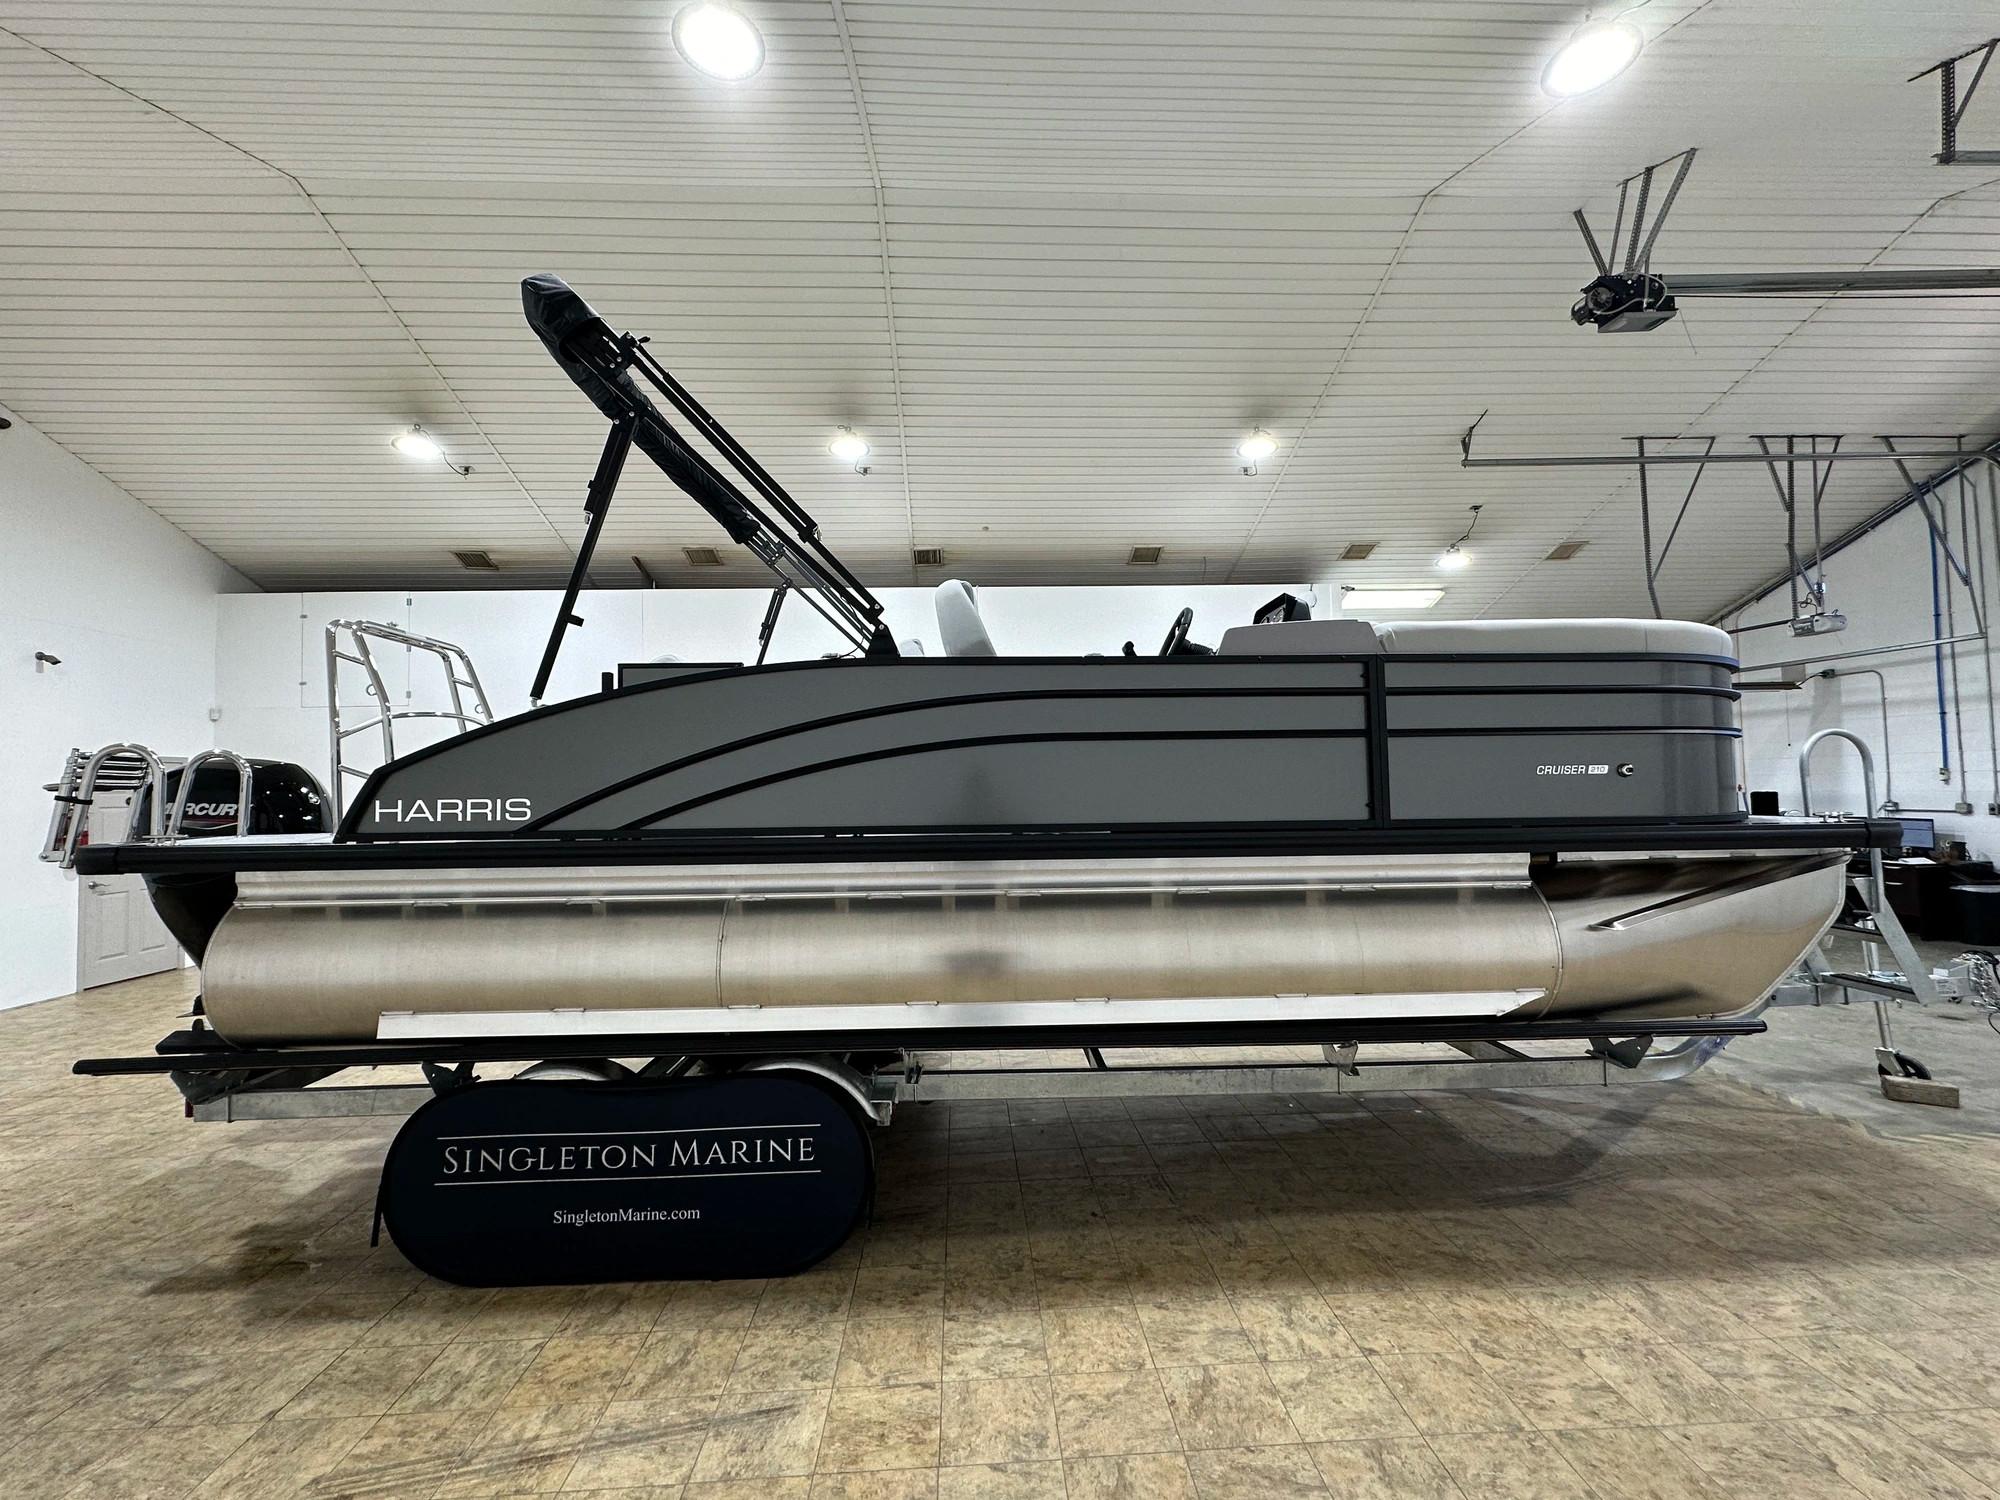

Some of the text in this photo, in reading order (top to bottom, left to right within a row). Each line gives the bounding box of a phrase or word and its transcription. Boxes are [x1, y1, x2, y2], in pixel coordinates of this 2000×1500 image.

[1536, 765, 1586, 775] CRUISER
[374, 798, 532, 823] HARRIS
[443, 1137, 815, 1174] SINGLETON MARINE
[553, 1208, 700, 1226] SingletonMarine.com
